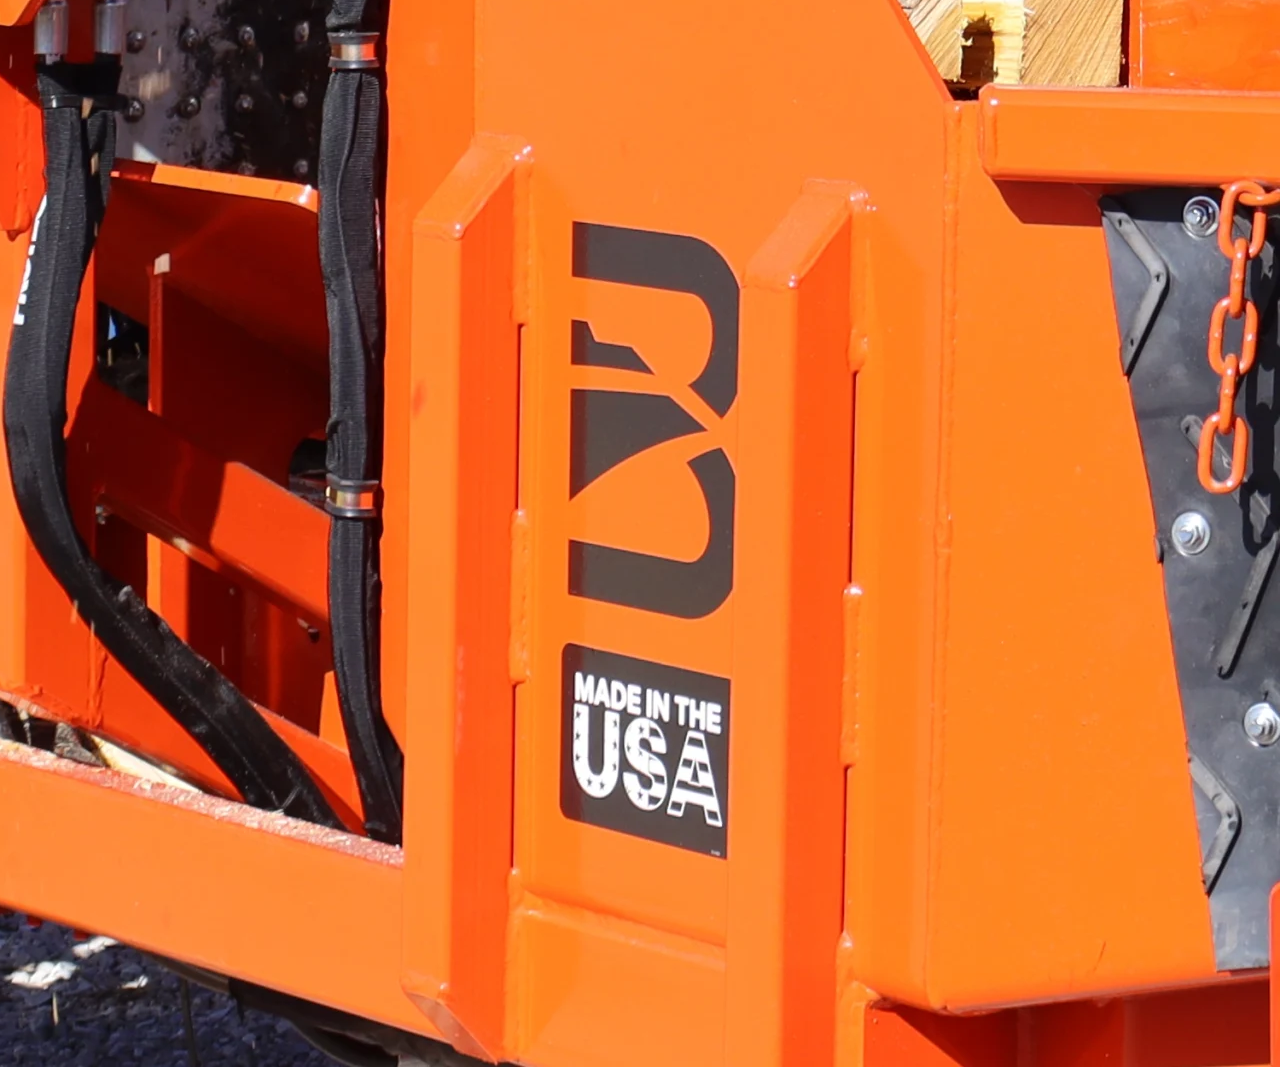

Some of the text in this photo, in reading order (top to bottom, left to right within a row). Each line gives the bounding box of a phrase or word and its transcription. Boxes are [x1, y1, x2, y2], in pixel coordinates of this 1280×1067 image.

[574, 671, 722, 735] MADE IN THE
[572, 702, 723, 828] USA
